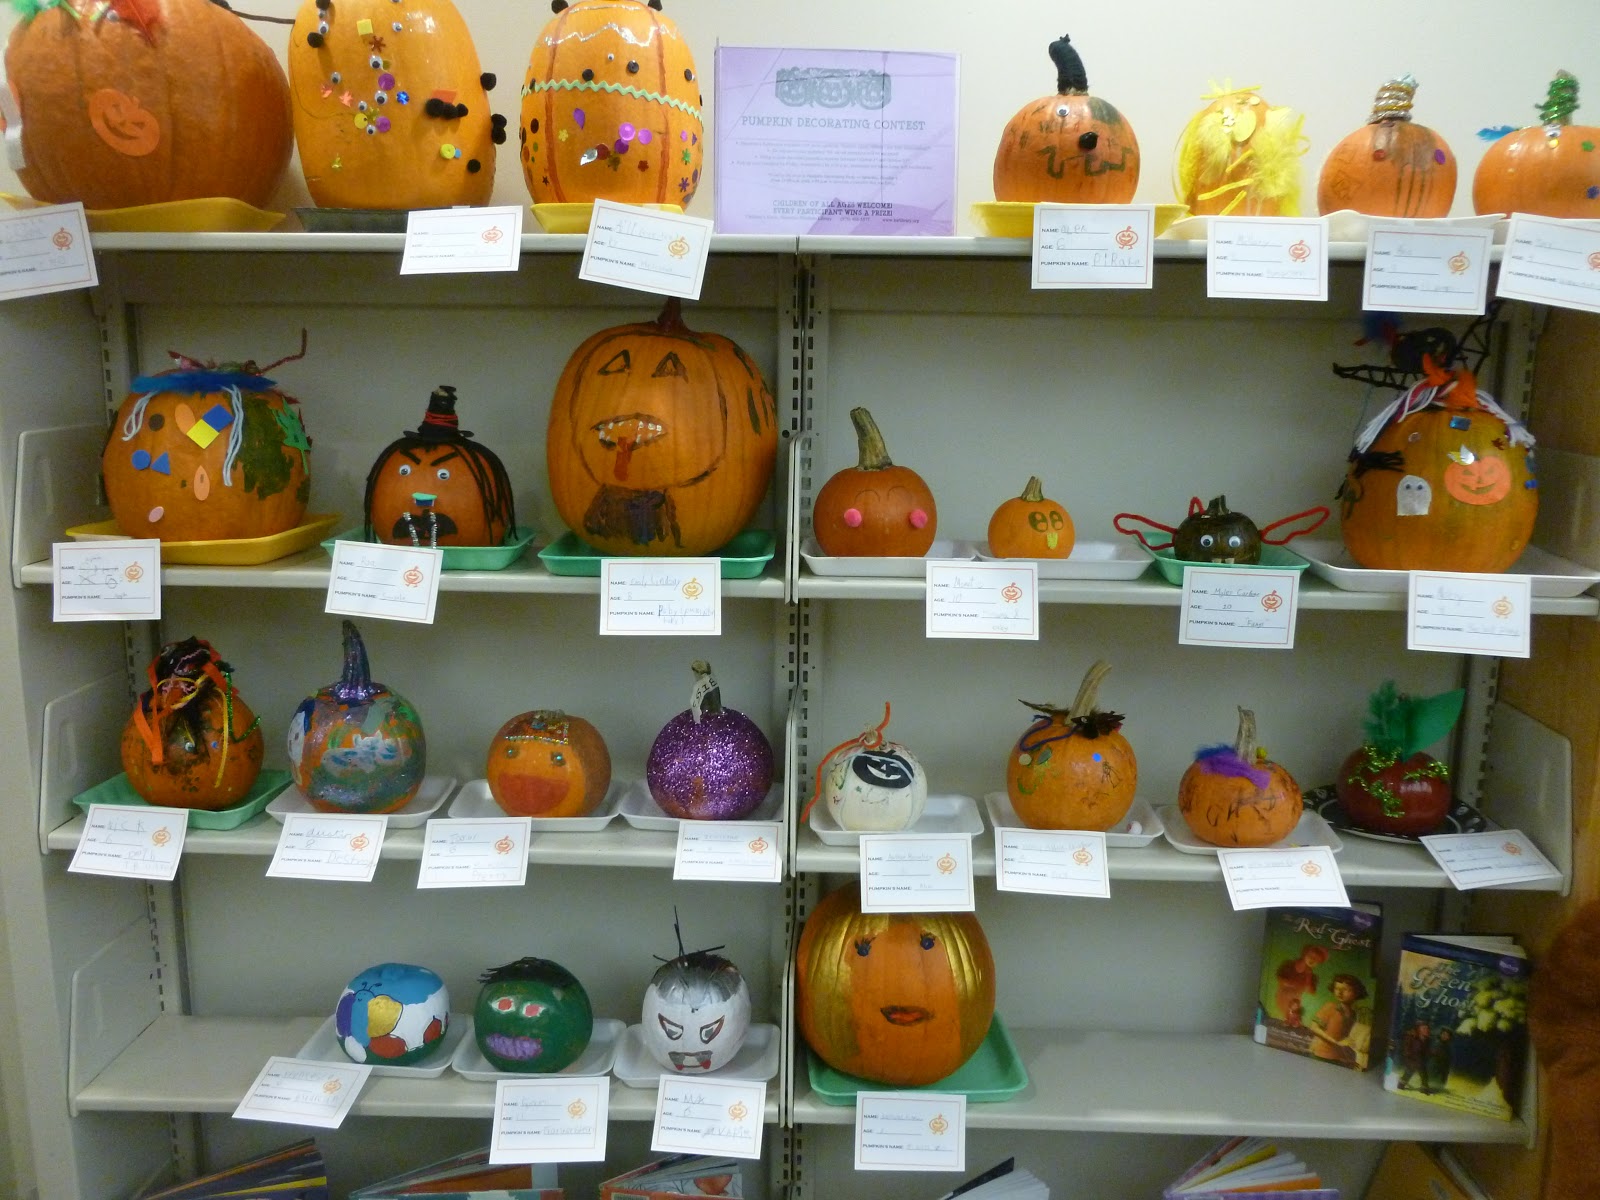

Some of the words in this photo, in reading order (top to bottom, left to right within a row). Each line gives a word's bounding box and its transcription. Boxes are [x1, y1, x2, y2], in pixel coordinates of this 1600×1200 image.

[742, 116, 792, 128] PUMPKIN
[798, 117, 870, 129] DECORATING
[874, 120, 926, 131] CONTEST
[1294, 918, 1329, 939] Red
[1411, 966, 1472, 991] Green
